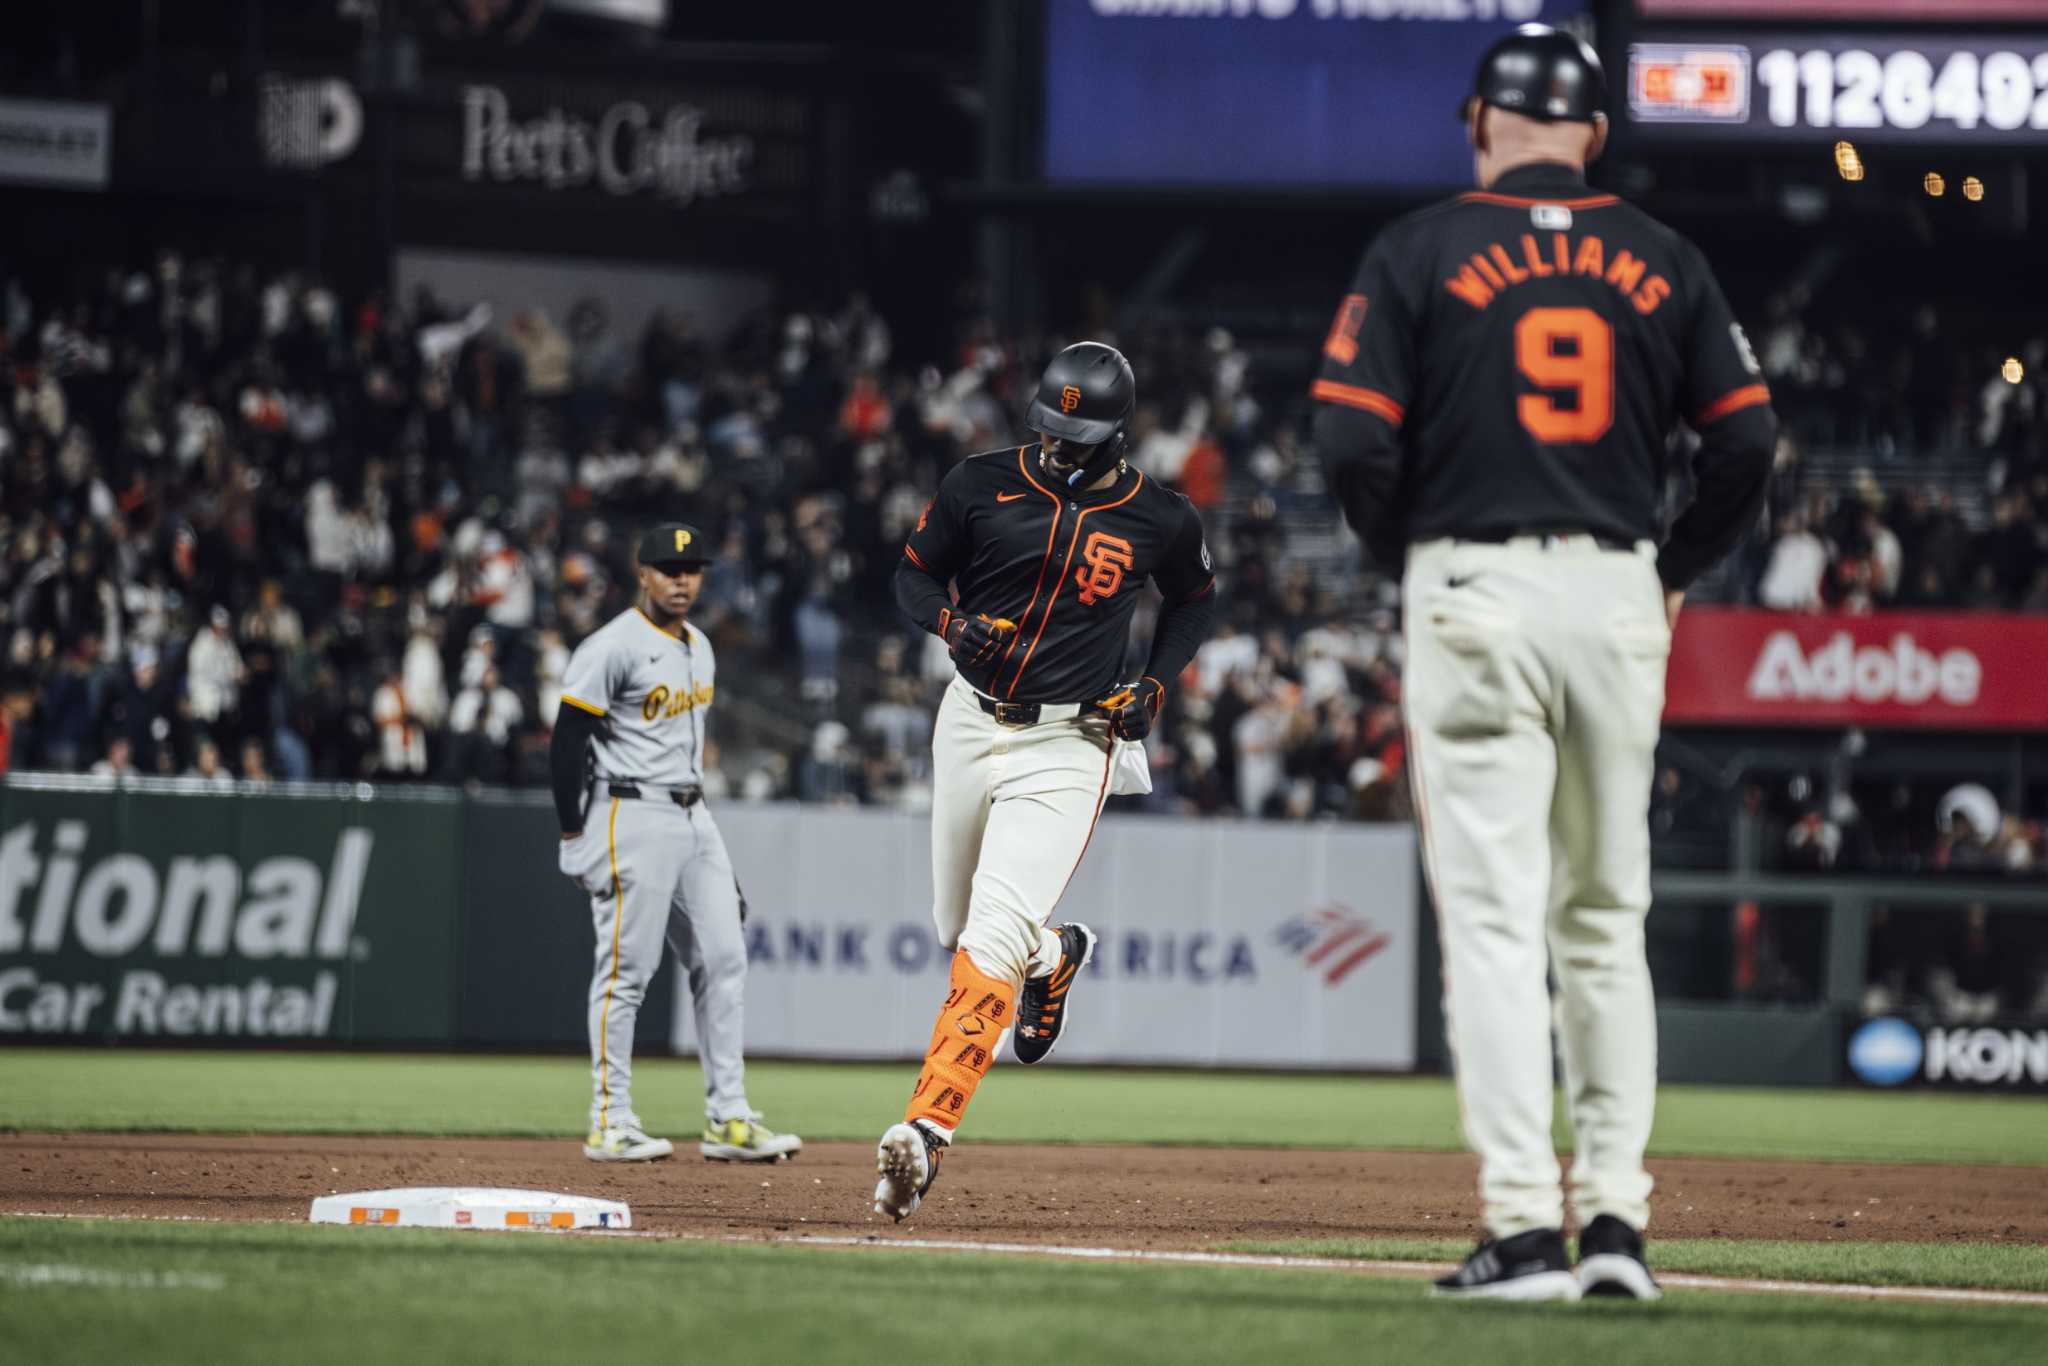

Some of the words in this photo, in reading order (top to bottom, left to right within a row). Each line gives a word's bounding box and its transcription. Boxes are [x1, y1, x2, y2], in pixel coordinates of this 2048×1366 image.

[600, 101, 754, 206] Coffee
[1444, 233, 1672, 315] WILLIAMS
[1514, 306, 1615, 444] 9
[674, 529, 692, 553] P
[1075, 531, 1134, 606] SF
[1748, 629, 1983, 706] Adobe
[746, 920, 870, 970] ANK
[1088, 926, 1260, 985] ERICA
[0, 967, 104, 1033] Car
[115, 969, 338, 1036] Rental
[1924, 1026, 2048, 1084] KON
